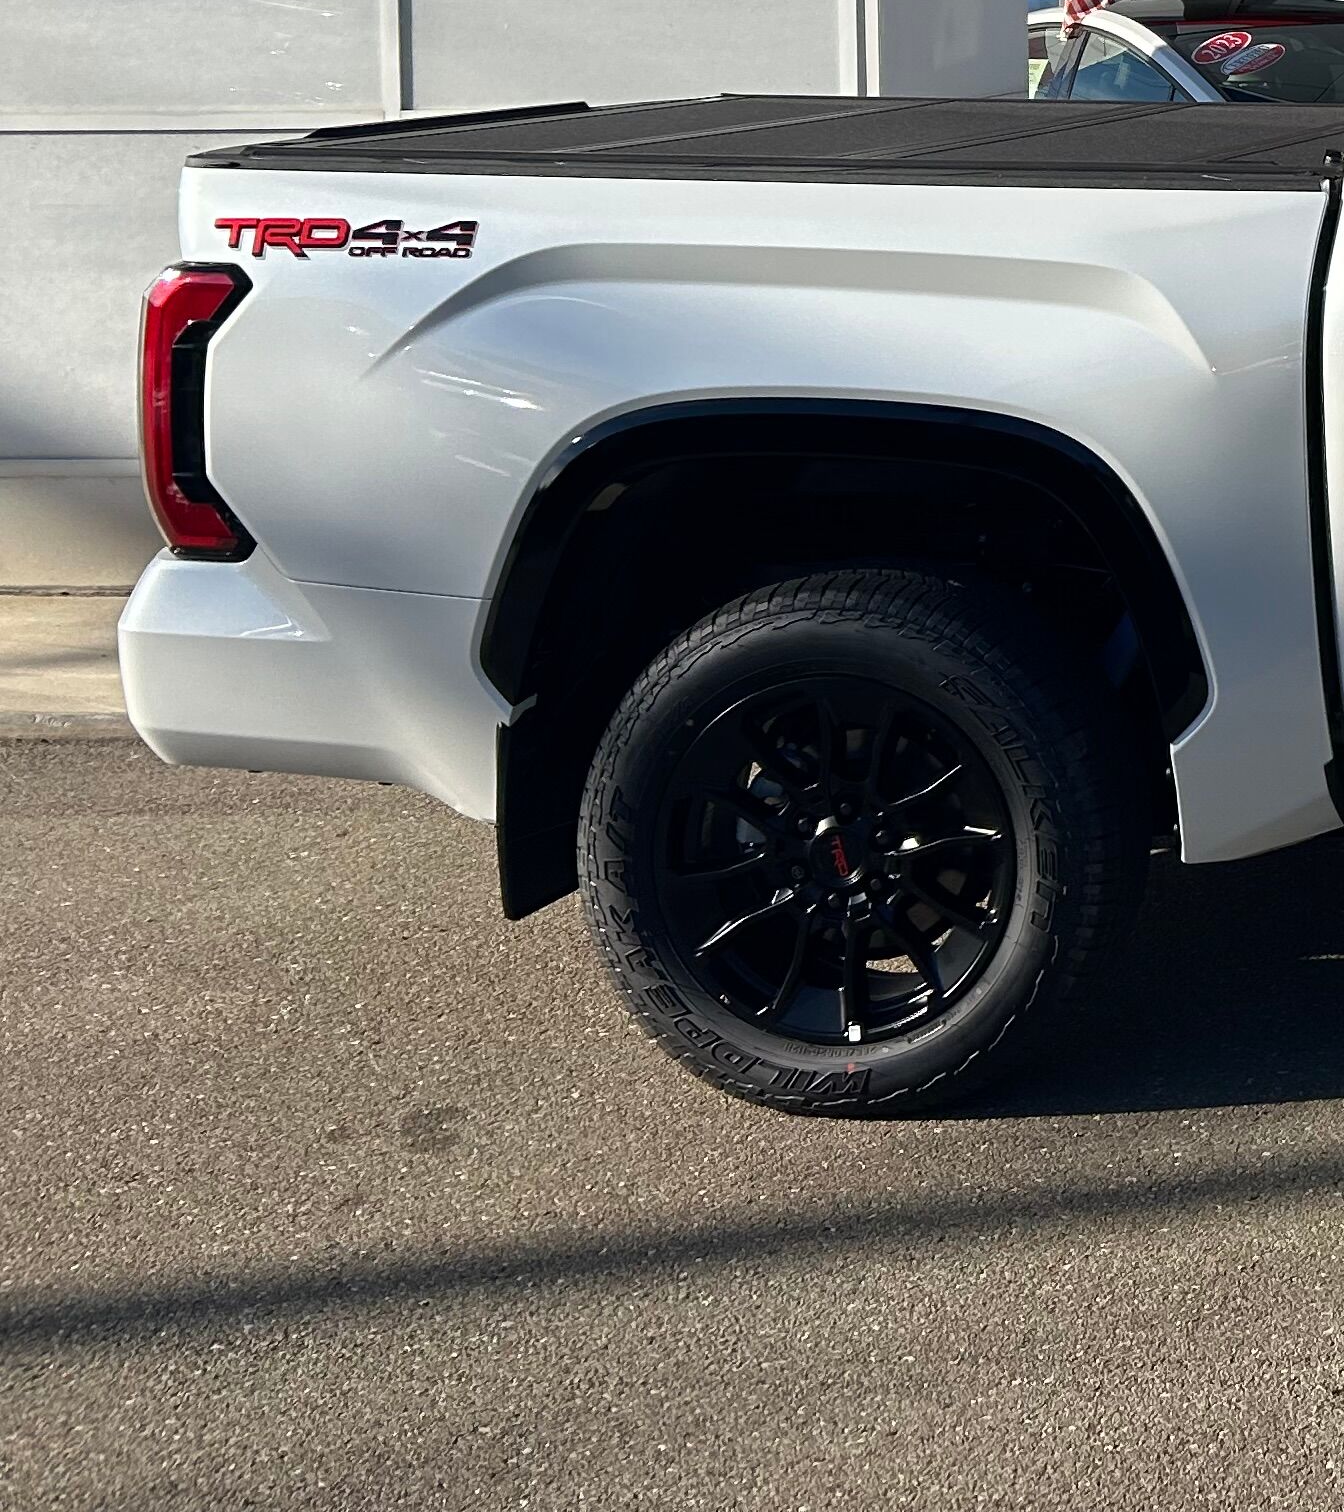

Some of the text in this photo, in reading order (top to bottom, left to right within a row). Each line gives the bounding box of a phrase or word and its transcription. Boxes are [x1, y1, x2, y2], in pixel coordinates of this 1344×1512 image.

[1201, 33, 1243, 60] 2023
[214, 217, 352, 261] TRD
[349, 246, 473, 259] OFF ROAD
[939, 673, 1060, 934] FALKEN
[829, 833, 850, 878] TRD
[606, 902, 874, 1099] WILDPEAK
